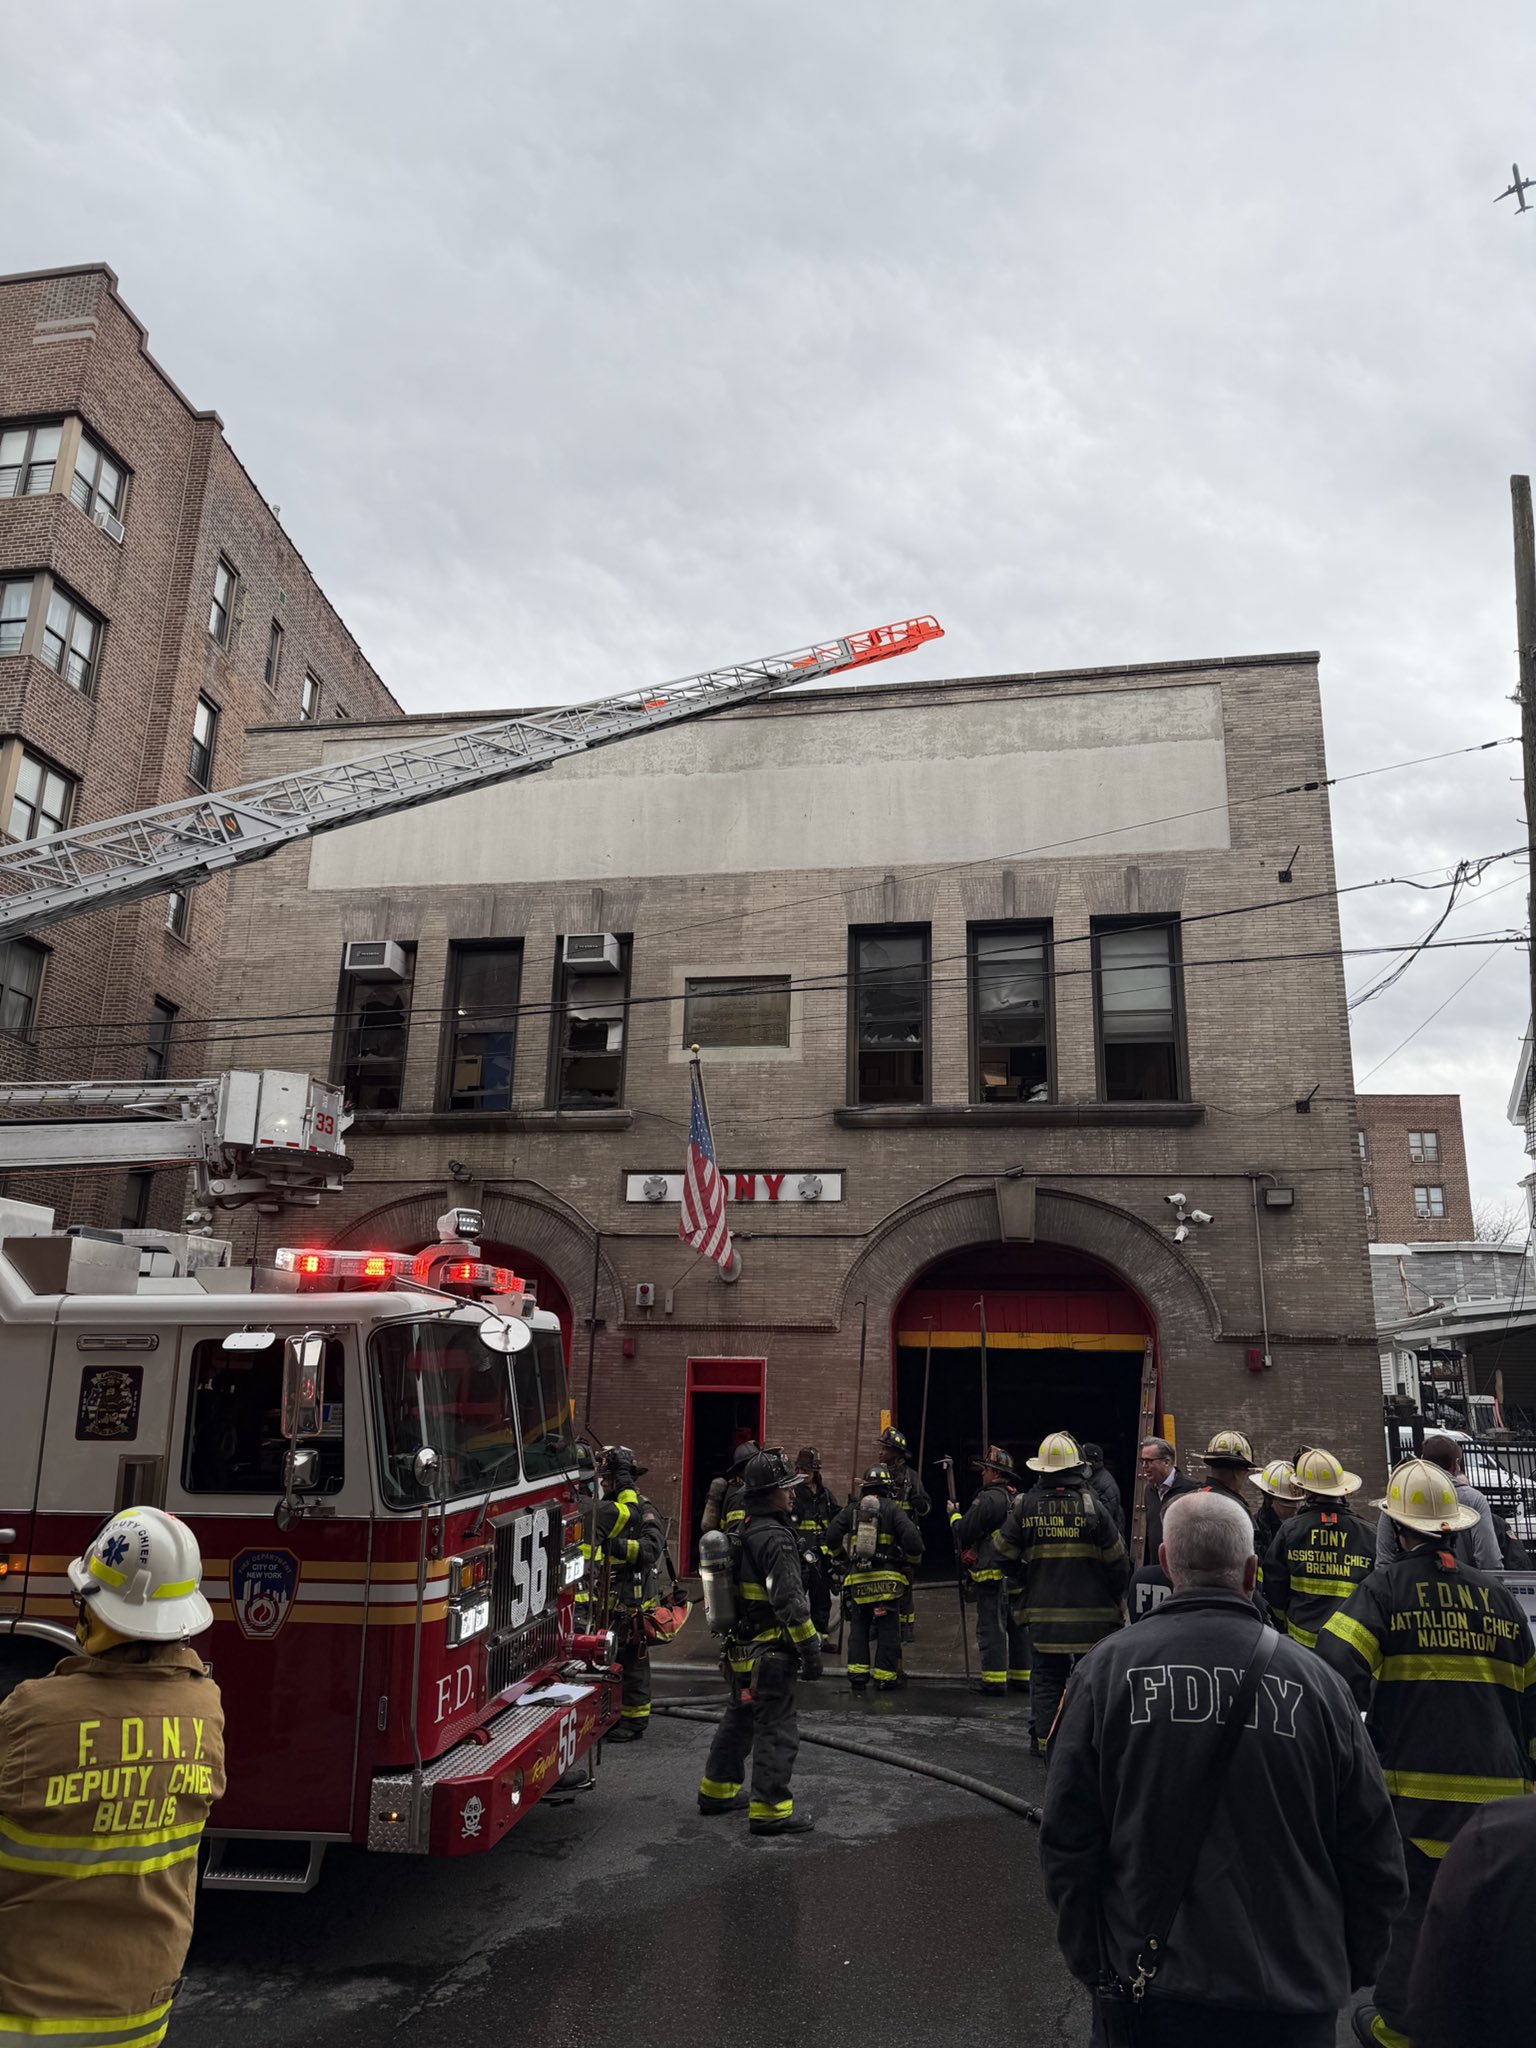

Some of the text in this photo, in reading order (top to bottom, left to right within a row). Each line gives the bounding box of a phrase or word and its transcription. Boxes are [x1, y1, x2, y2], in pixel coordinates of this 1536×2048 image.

[315, 1112, 334, 1135] 33
[720, 1174, 785, 1200] NY
[1038, 1527, 1080, 1538] O'CONNOR
[1311, 1529, 1348, 1548] FDNY
[138, 1529, 149, 1565] CHIEF
[1287, 1549, 1372, 1569] ASSISTANT CHIEF
[511, 1508, 549, 1628] 56
[1306, 1562, 1350, 1577] BRENNAN
[856, 1581, 897, 1596] FERNANDEZ
[1483, 1615, 1520, 1640] CHIEF
[1417, 1629, 1497, 1653] NAUGHTON
[1127, 1665, 1303, 1738] FDNY
[558, 1708, 577, 1776] 56
[45, 1765, 153, 1807] DEPUTY
[93, 1796, 177, 1832] BLELIS
[468, 1803, 479, 1812] 56
